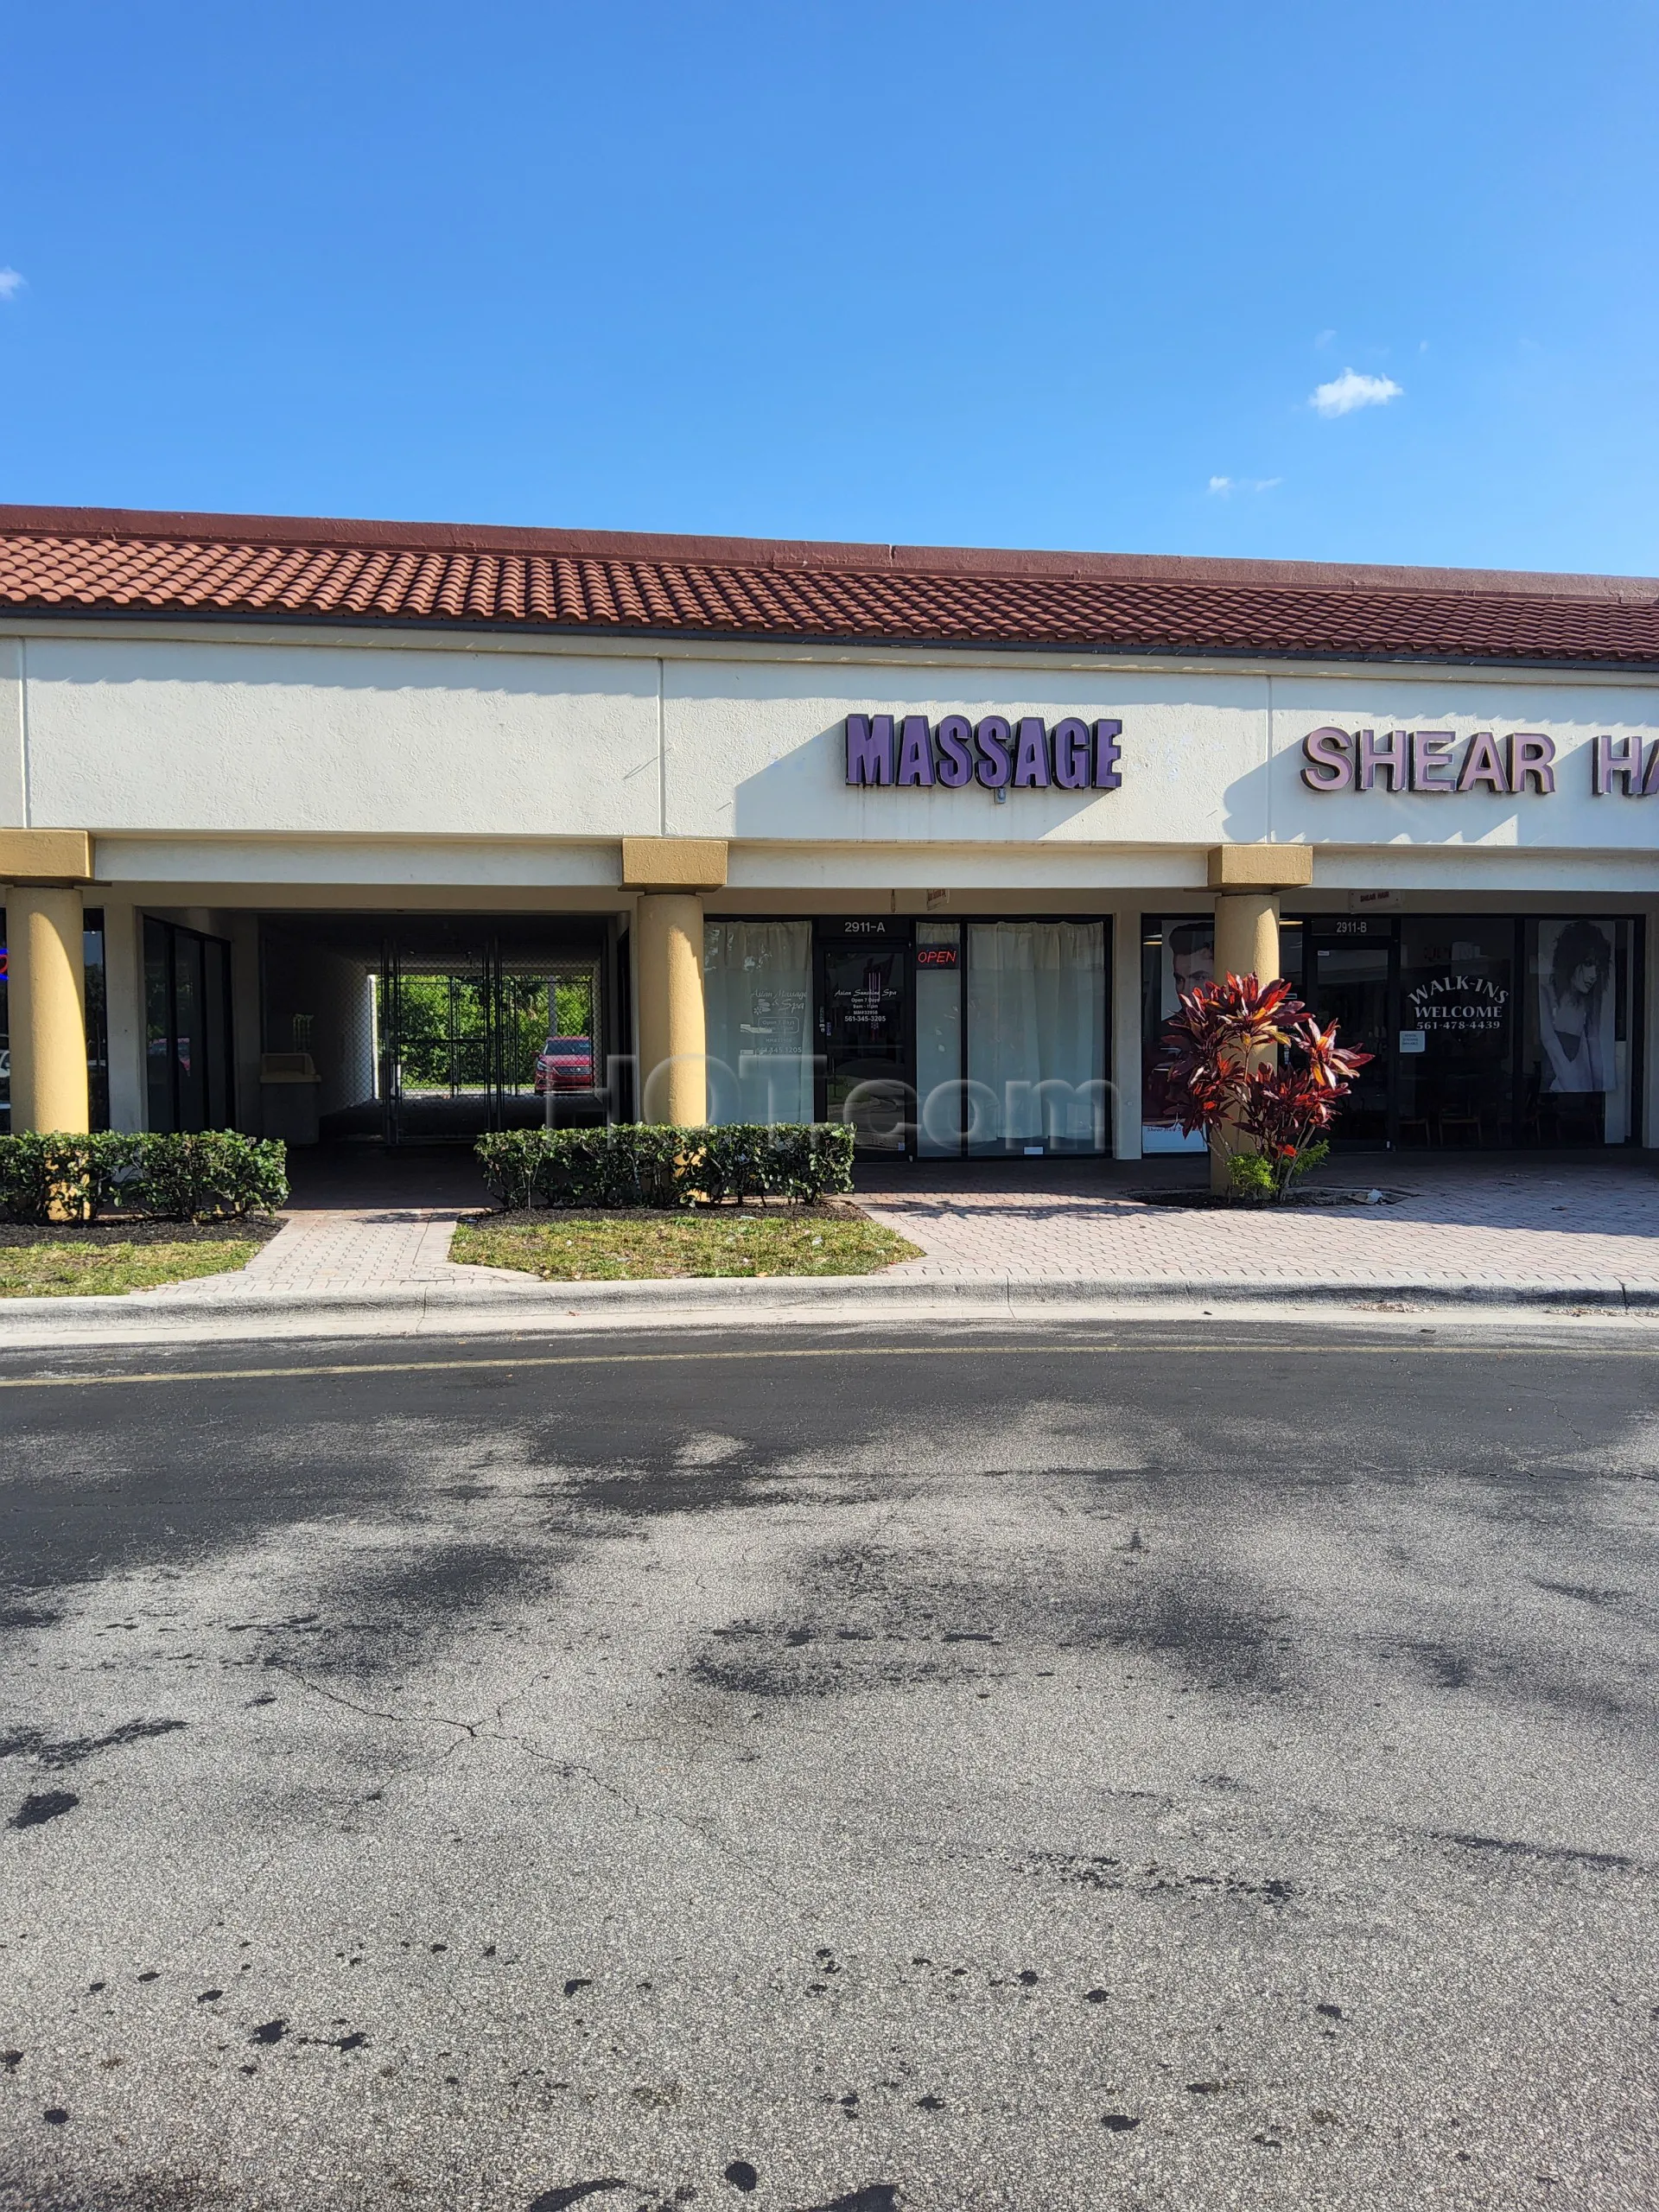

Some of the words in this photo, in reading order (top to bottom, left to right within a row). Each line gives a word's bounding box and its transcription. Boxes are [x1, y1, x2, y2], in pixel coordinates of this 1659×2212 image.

[845, 713, 1122, 788] MASSAGE
[1300, 726, 1556, 793] SHEAR
[844, 921, 886, 932] 2911-A
[1336, 921, 1367, 933] 2911-B
[918, 950, 957, 963] OPEN
[853, 988, 880, 997] Sunshine
[881, 988, 897, 997] Spa
[1407, 976, 1510, 1005] WALK-INS
[779, 998, 805, 1014] Spa
[1414, 1006, 1503, 1018] WELCOME
[1416, 1020, 1501, 1030] 561-478-4439
